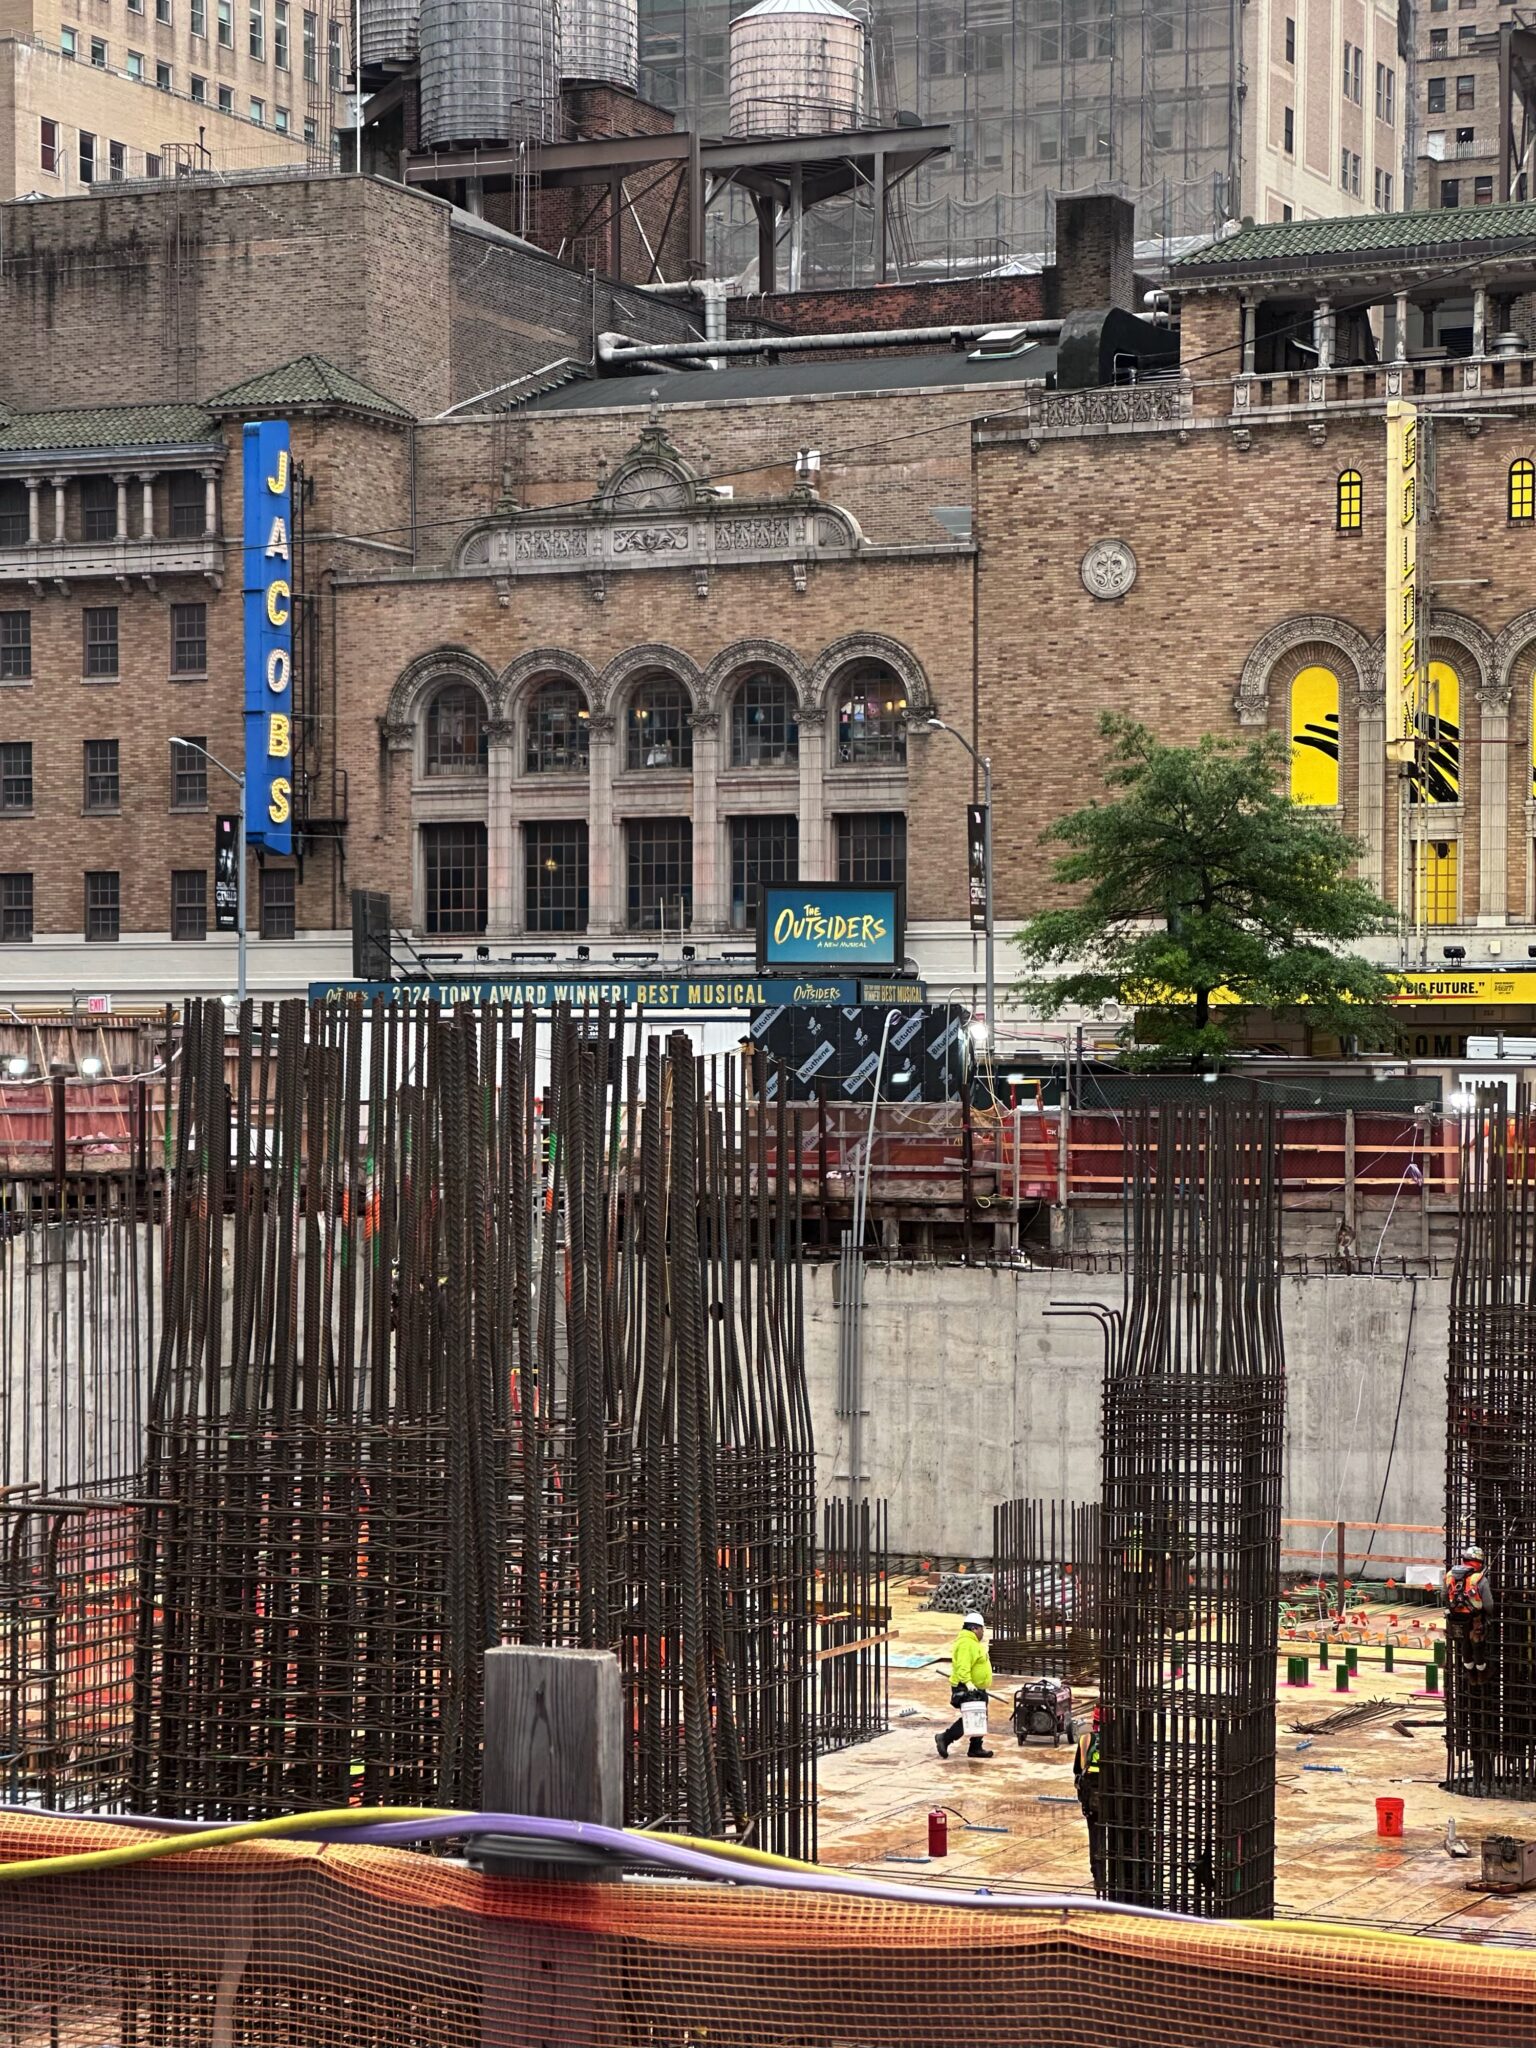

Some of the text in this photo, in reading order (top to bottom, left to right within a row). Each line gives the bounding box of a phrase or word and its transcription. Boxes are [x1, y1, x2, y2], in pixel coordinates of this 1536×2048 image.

[266, 450, 291, 824] JACOBS
[803, 904, 822, 916] THE
[774, 908, 887, 944] OUTSIDERS
[840, 941, 868, 949] MUSICAL
[439, 985, 482, 1005] TONY
[490, 985, 547, 1005] AWARD
[554, 985, 628, 1005] WINNER!
[637, 985, 680, 1005] BEST
[688, 984, 766, 1005] MUSICAL
[793, 985, 841, 1002] OUTSIDERS
[881, 985, 897, 1003] BEST
[90, 998, 105, 1011] EXIT
[800, 1047, 830, 1080] Bituthene
